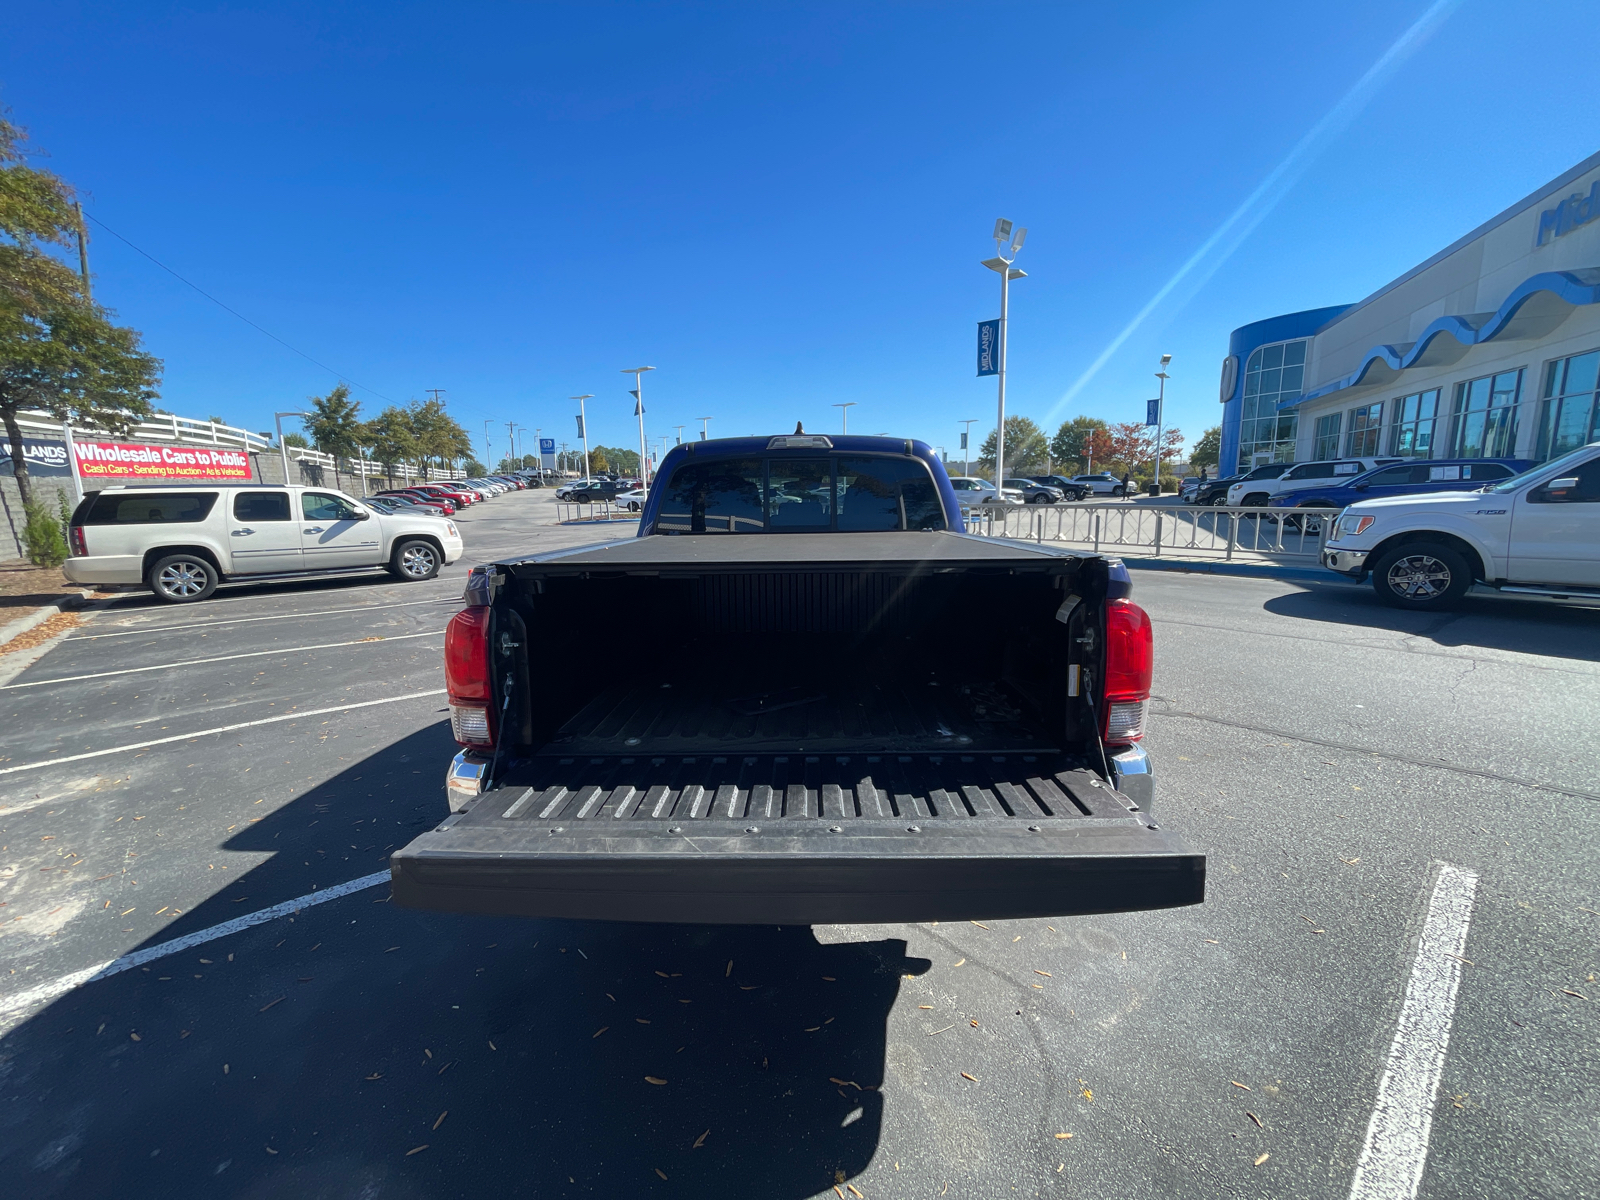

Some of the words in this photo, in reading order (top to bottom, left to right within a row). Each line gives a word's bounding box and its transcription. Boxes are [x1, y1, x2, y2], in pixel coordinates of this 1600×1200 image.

[74, 443, 162, 463] Wholesale
[162, 448, 196, 464] Cars
[195, 451, 211, 465] to
[210, 451, 247, 466] Public
[83, 463, 108, 474] Cash
[108, 464, 129, 475] Cars
[133, 465, 167, 477] Sending
[167, 466, 176, 476] to
[176, 466, 202, 476] Auction
[206, 467, 215, 477] As
[221, 467, 245, 477] Vehicles
